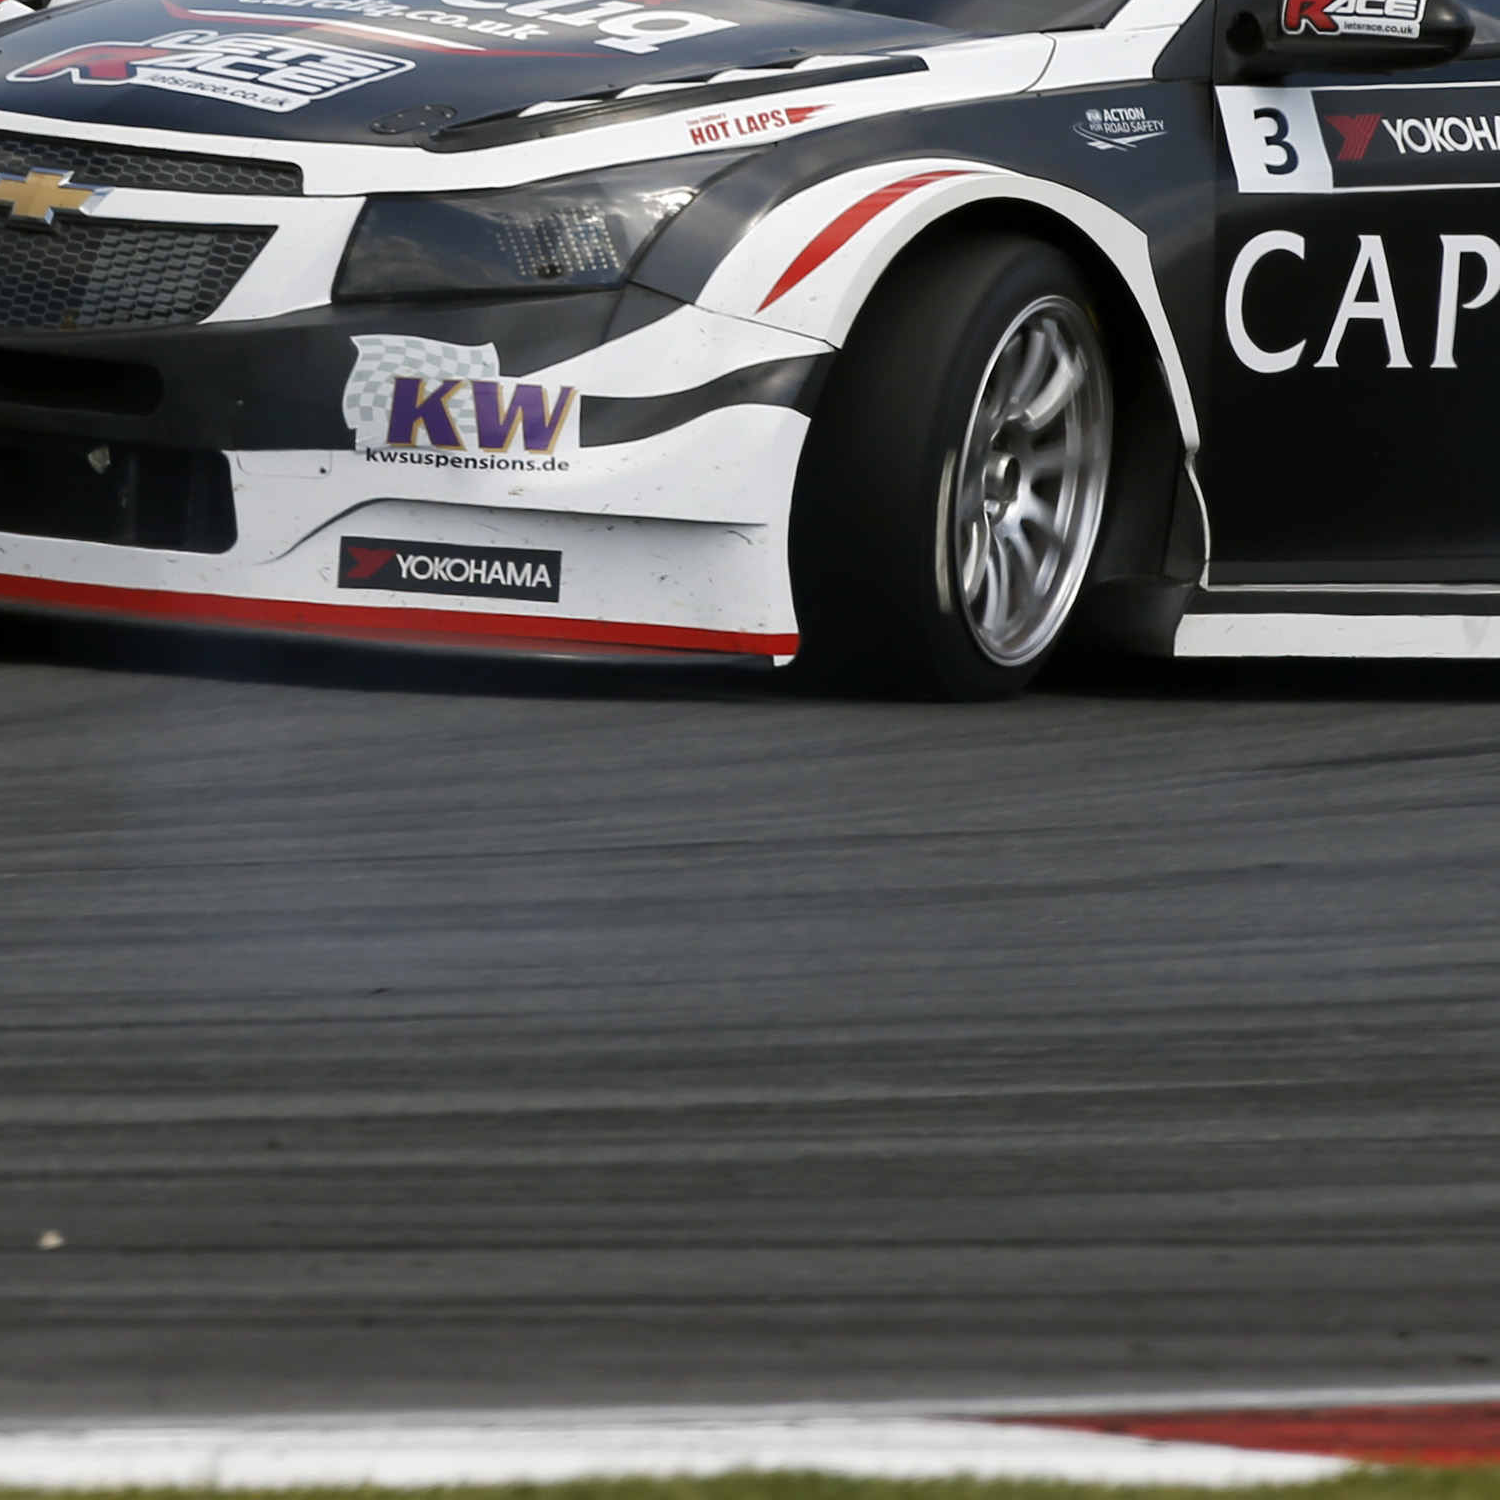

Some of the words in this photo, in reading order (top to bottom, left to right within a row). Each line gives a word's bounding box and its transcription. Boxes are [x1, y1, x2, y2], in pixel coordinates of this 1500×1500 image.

[690, 120, 731, 146] HOT
[733, 109, 786, 136] LAPS
[1103, 106, 1147, 122] ACTION
[1104, 120, 1130, 134] ROAD
[1130, 119, 1165, 133] SAFETY
[1253, 107, 1299, 175] 3
[386, 375, 578, 456] KW
[365, 446, 570, 473] kwsuspensions.de
[395, 553, 552, 588] YOKOHAMA
